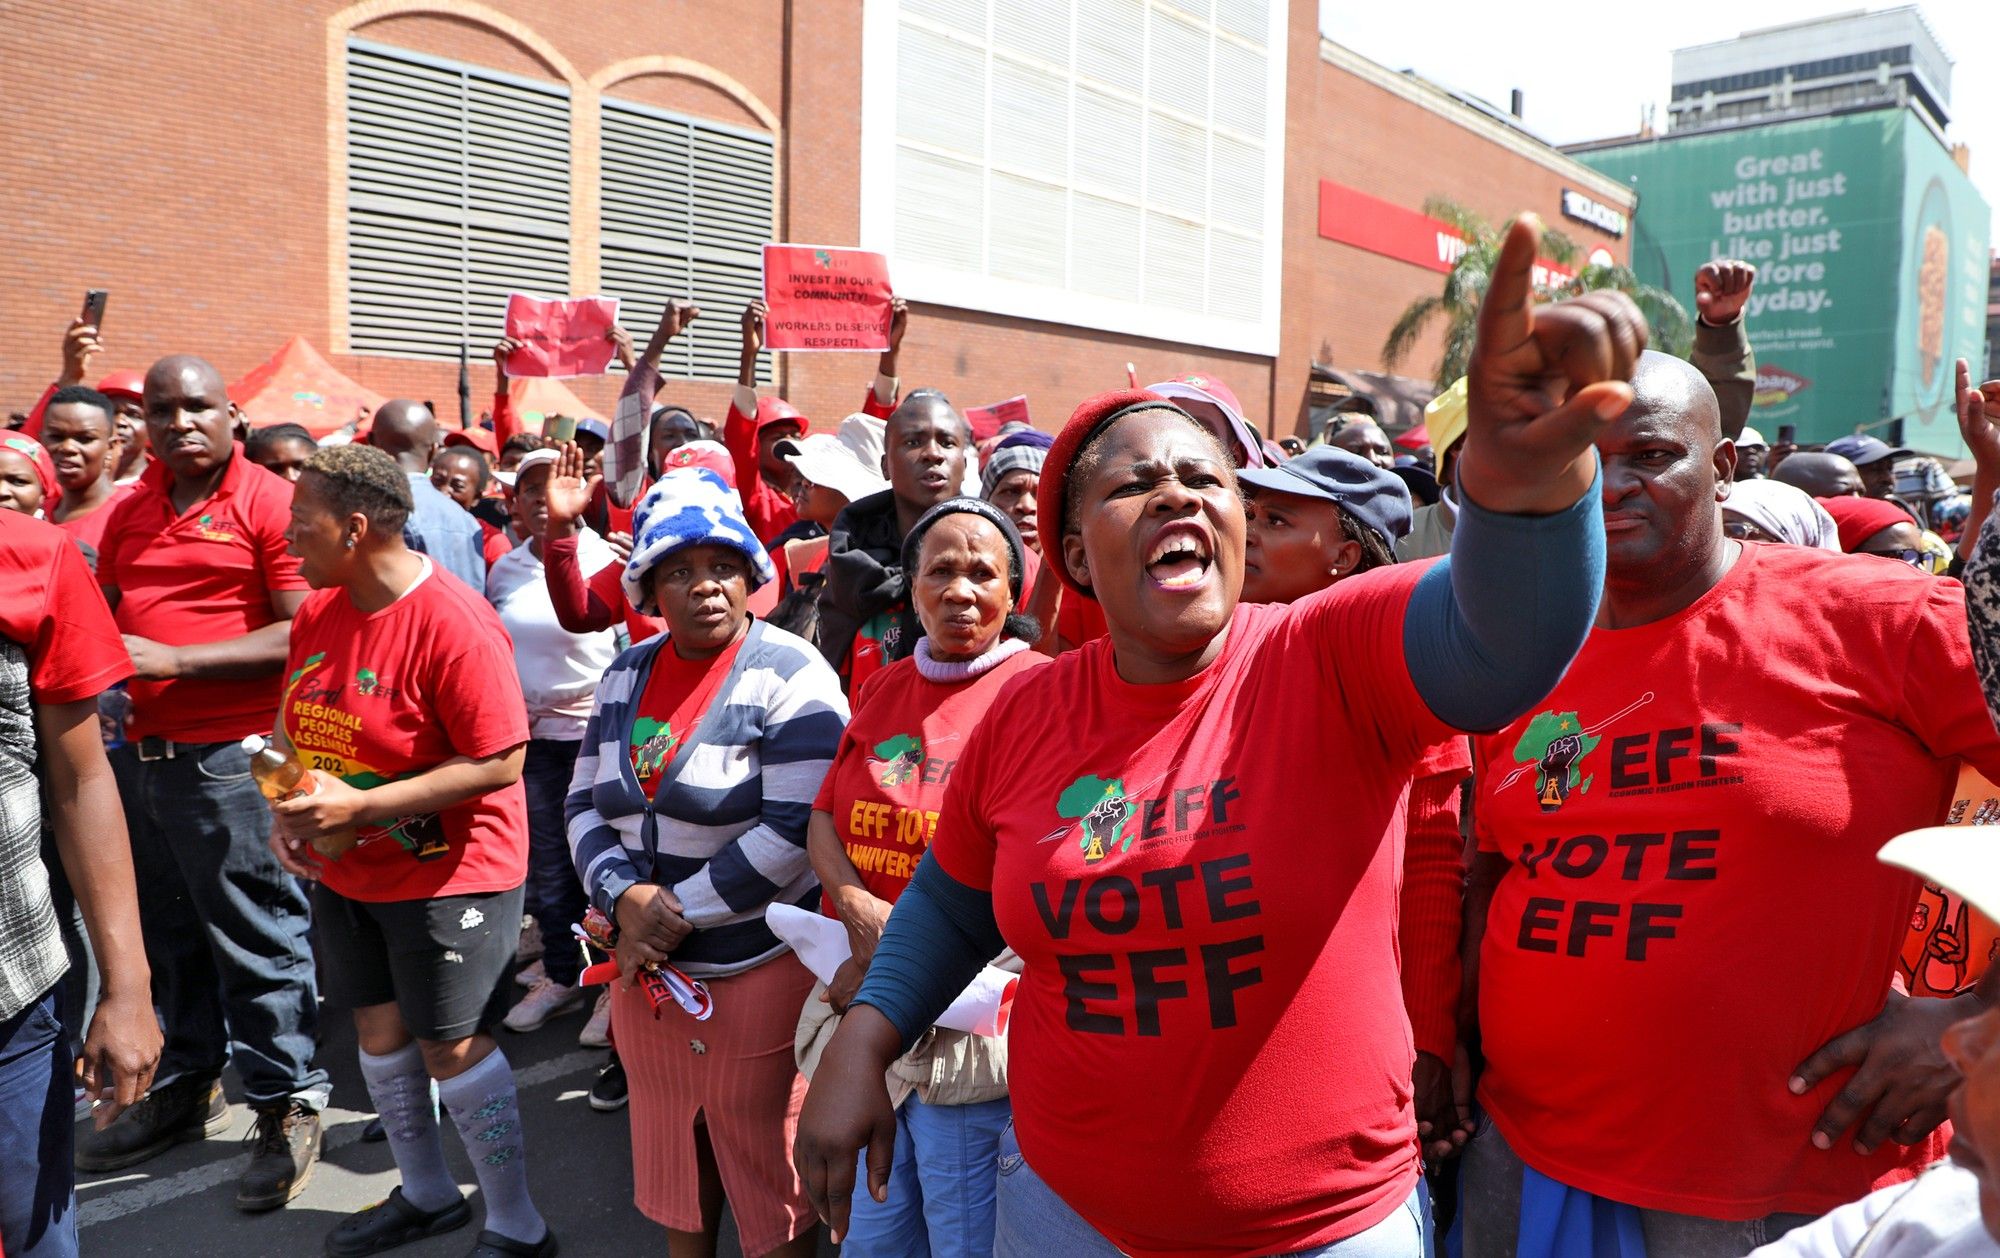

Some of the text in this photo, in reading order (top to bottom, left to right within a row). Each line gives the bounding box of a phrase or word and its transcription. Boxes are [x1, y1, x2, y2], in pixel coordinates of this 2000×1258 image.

[1735, 148, 1823, 179] Great
[1711, 172, 1847, 209] with just
[1724, 206, 1829, 234] butter.
[1710, 229, 1842, 262] Like just
[788, 274, 873, 286] INVEST IN OUR
[1754, 260, 1826, 285] fore
[1750, 287, 1833, 317] yday.
[775, 321, 886, 333] WORKERS DESERVE
[804, 337, 860, 348] RESPECT!
[293, 701, 363, 732] REGIONAL
[299, 716, 353, 743] PEOPLES
[312, 755, 343, 773] 202
[919, 757, 957, 784] EF
[1610, 722, 1743, 789] EFF
[1608, 775, 1744, 798] ECONOMIC FREEDOM FIGHTERS
[1141, 775, 1240, 841] EFF
[851, 800, 940, 848] EFF 10T
[1140, 837, 1174, 851] ECONOMIC
[1175, 830, 1209, 844] FREEDOM
[1518, 828, 1721, 881] VOTE
[1029, 852, 1262, 940] VOTE
[1516, 896, 1683, 962] EFF
[1056, 934, 1265, 1038] EFF
